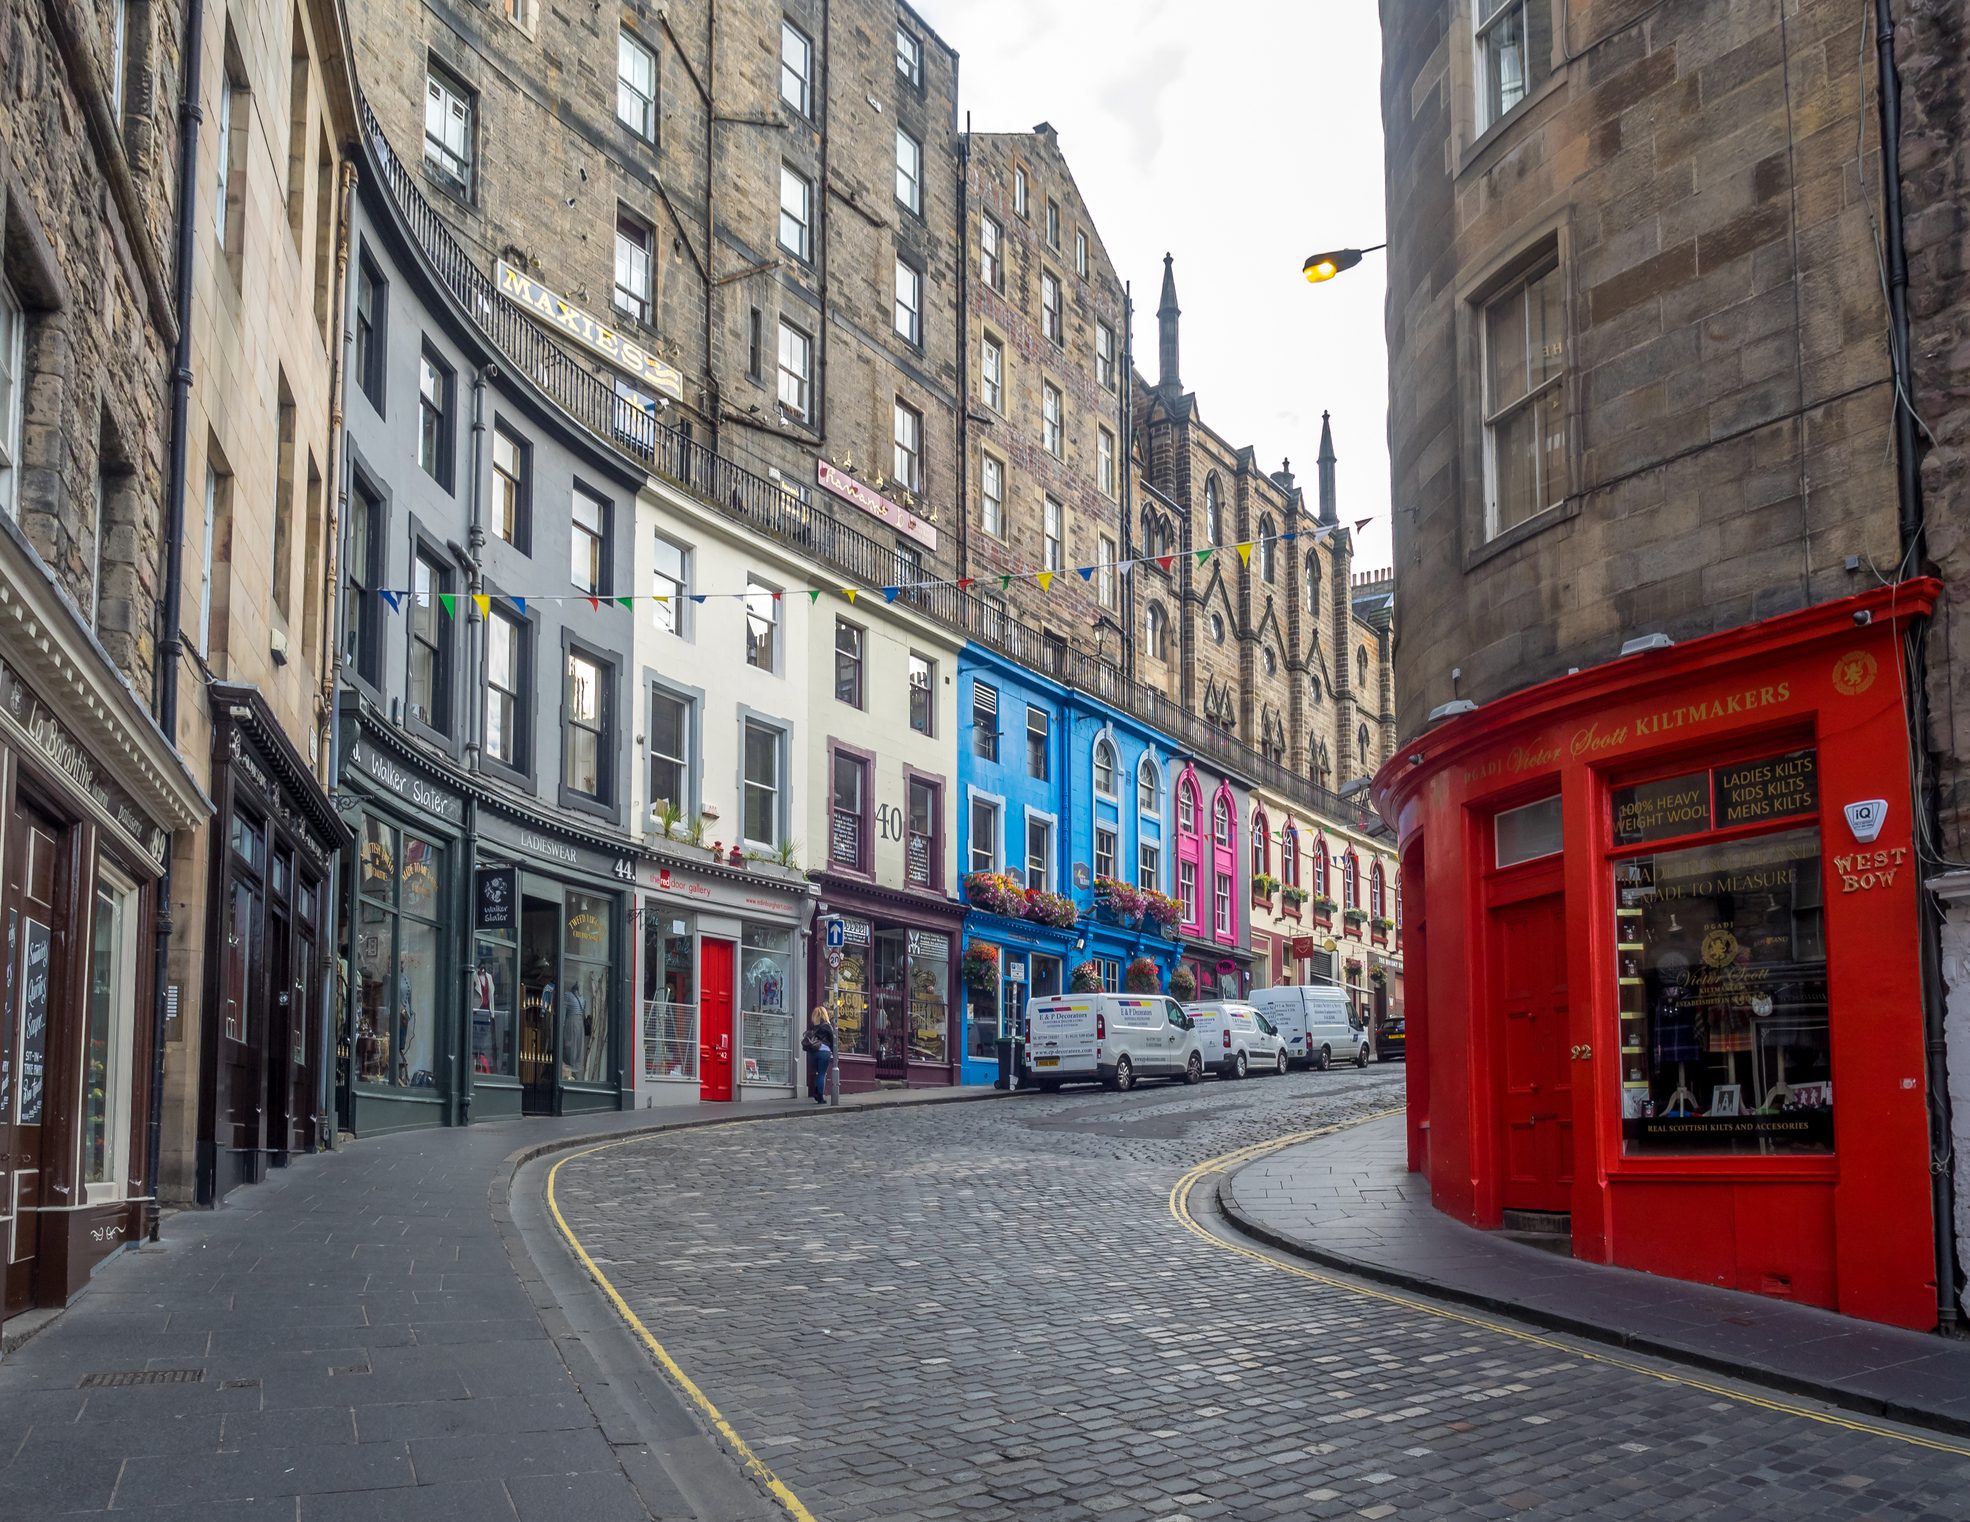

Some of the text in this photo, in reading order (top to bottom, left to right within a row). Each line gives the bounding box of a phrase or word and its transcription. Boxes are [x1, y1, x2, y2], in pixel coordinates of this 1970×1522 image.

[503, 268, 644, 371] MAXIES
[1507, 737, 1562, 774] Victor
[1570, 720, 1628, 761] Scott
[1636, 682, 1791, 736] KILTMAKERS
[29, 700, 44, 743] La
[46, 718, 94, 792] Barantine
[372, 753, 448, 814] Walker Slater
[1723, 757, 1813, 789] LADIES KILTS
[1620, 790, 1700, 818] 100% HEAVY
[1732, 777, 1805, 803] KIDS KILTS
[1612, 804, 1710, 834] WEIGHT WOOL
[1727, 792, 1812, 821] MENS KILTS
[875, 803, 903, 842] 40
[151, 827, 166, 863] 89
[521, 831, 577, 863] LADIESWEAR
[1834, 847, 1907, 875] WEST
[650, 872, 712, 898] the red door gallery
[1640, 869, 1798, 905] MADE TO MEASURE
[1843, 868, 1897, 893] BOW
[1704, 921, 1734, 931] DGADI
[1676, 967, 1770, 988] Victor Scott
[1571, 1045, 1592, 1060] 92
[1647, 1121, 1809, 1133] REAL SCOTTISH KILTS AND ACCESORIES
